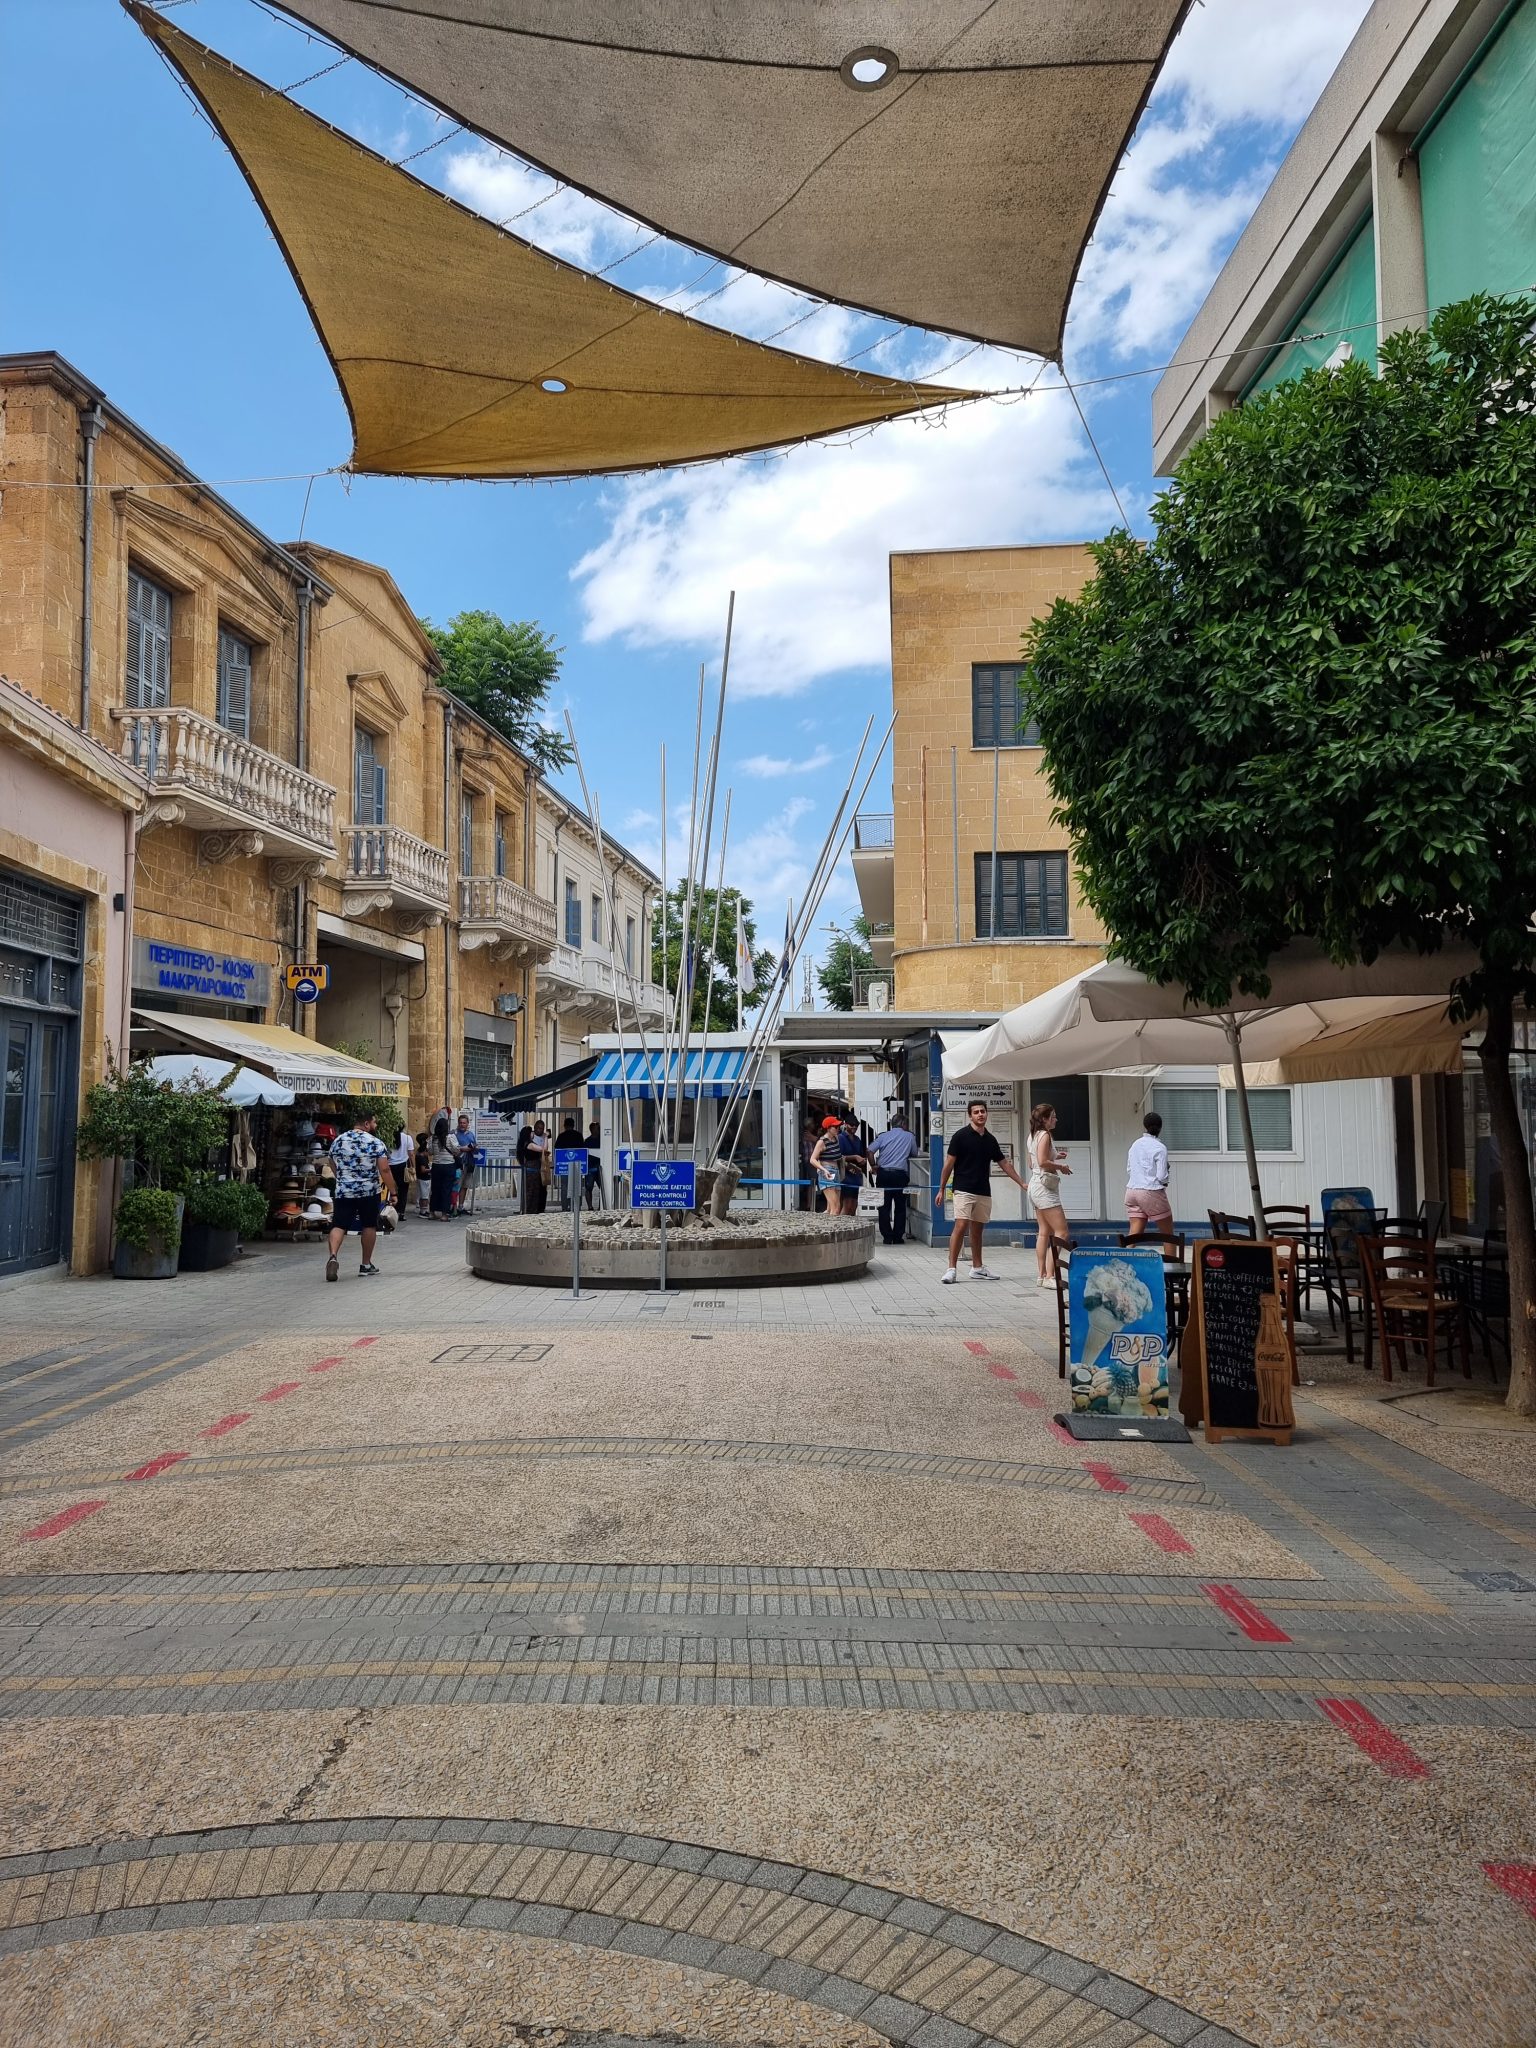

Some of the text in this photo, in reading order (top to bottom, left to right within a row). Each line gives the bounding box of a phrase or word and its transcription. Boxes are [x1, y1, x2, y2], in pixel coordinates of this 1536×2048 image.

[149, 944, 214, 972] ΠΕΡΙΠΤΕΡΟ
[223, 959, 255, 980] KIOSK
[291, 966, 322, 977] ATM
[159, 970, 246, 999] ΜΑΚΡΥΔΡΟΜΟΣ
[326, 1079, 348, 1093] KIOSK
[361, 1081, 377, 1093] ATM
[381, 1082, 399, 1094] HERE
